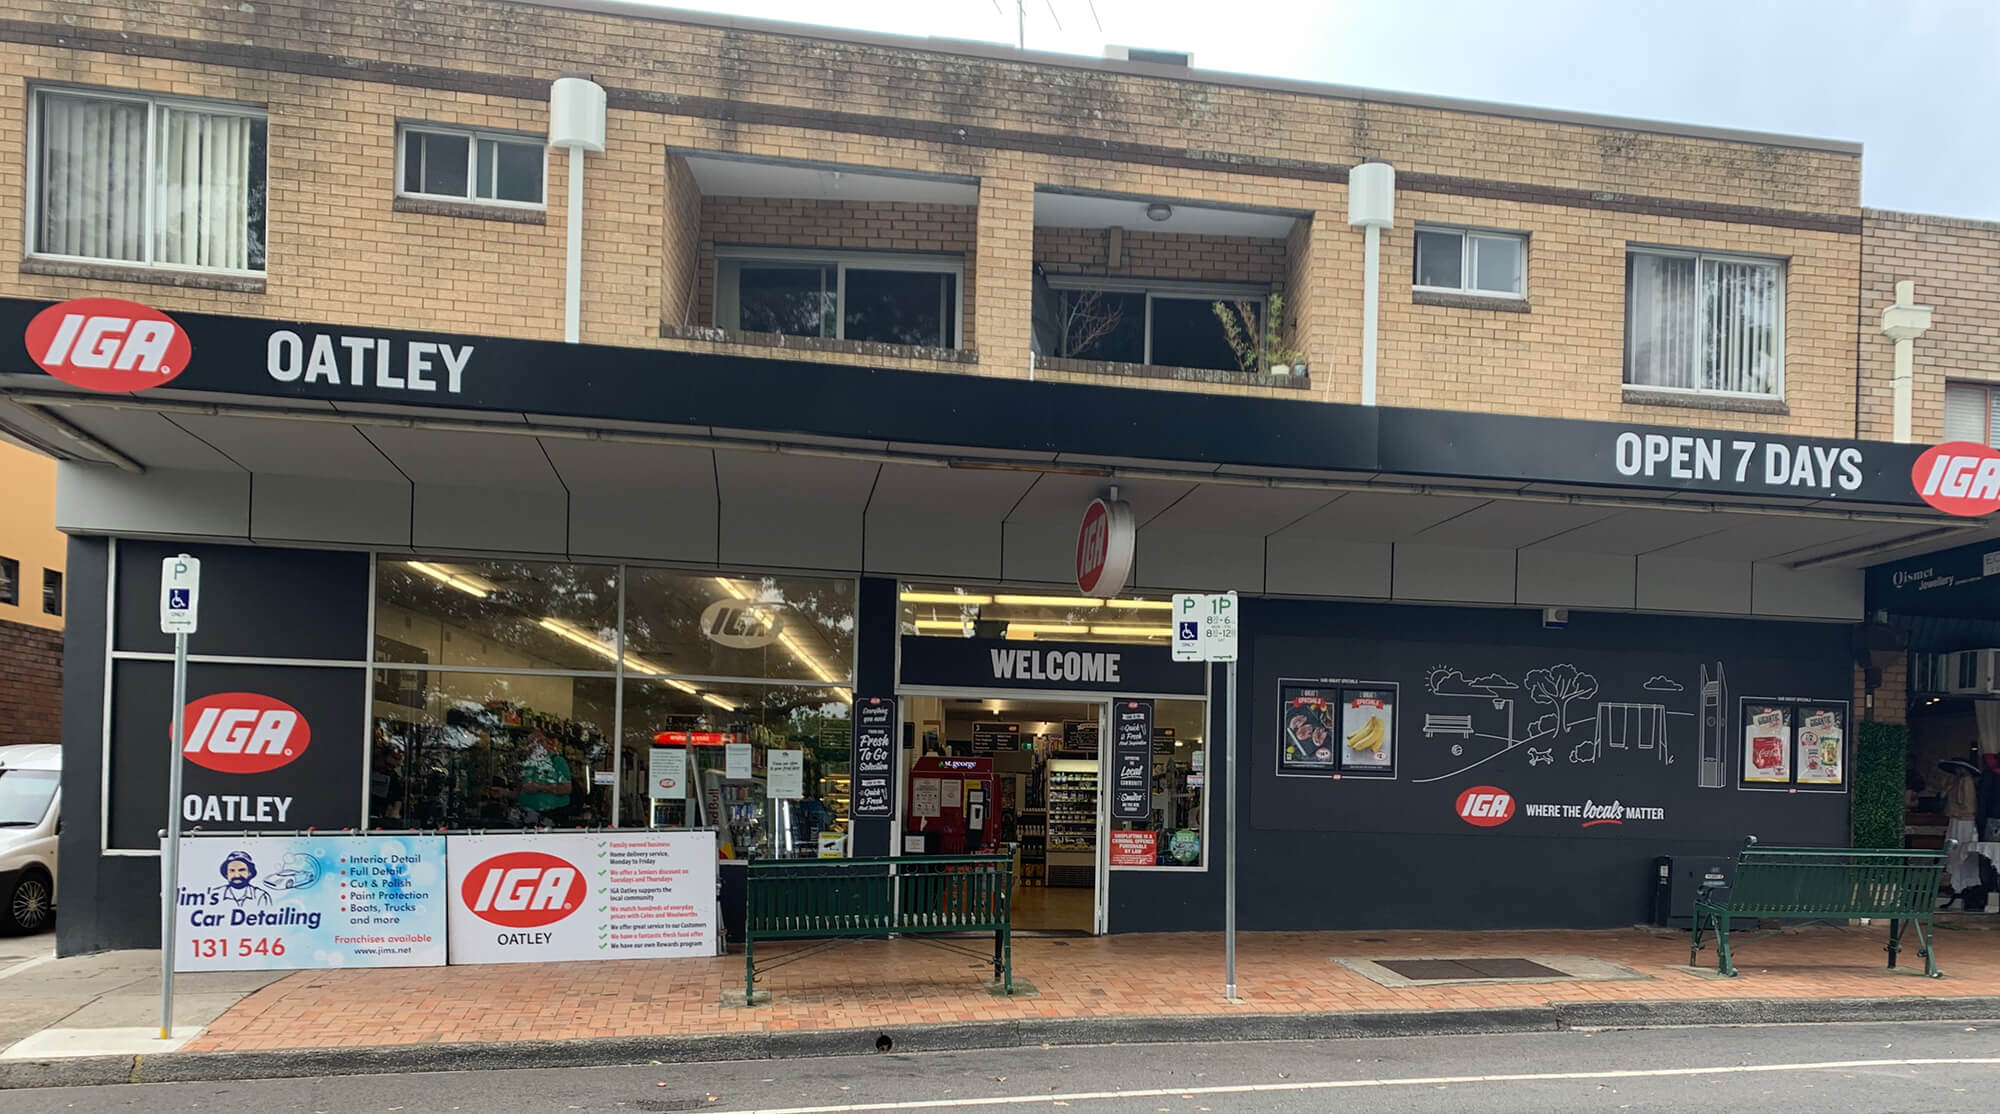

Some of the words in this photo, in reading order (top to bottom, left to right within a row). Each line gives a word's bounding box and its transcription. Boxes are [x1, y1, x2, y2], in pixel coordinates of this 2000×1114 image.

[42, 313, 175, 373] IGA
[267, 330, 474, 393] OATLEY
[1615, 432, 1722, 481] OPEN
[1732, 440, 1756, 482] 7
[1765, 443, 1863, 491] DAYS
[1080, 512, 1106, 579] IGA
[174, 561, 188, 580] P
[1183, 598, 1196, 614] P
[1212, 597, 1232, 614] 1P
[990, 648, 1121, 683] WELCOME
[183, 707, 298, 755] IGA
[860, 734, 889, 747] Fresh
[859, 748, 872, 761] To
[872, 748, 888, 761] Go
[1120, 765, 1143, 777] Local
[183, 794, 292, 822] OATLEY
[1461, 793, 1510, 818] IGA
[1526, 804, 1561, 817] WHERE
[1562, 805, 1581, 818] THE
[1582, 799, 1625, 820] locals
[1625, 807, 1664, 820] MATTER
[350, 855, 388, 863] Interior
[391, 854, 421, 863] Detail
[350, 867, 368, 876] Full
[372, 866, 402, 876] Detail
[350, 879, 368, 888] Cut
[371, 879, 378, 887] &
[382, 878, 412, 887] Polish
[473, 866, 577, 912] IGA
[350, 891, 376, 900] Paint
[379, 890, 429, 900] Protection
[350, 903, 381, 913] Boats,
[384, 903, 416, 911] Trucks
[190, 910, 225, 927] Car
[230, 907, 321, 930] Detailing
[350, 916, 370, 924] and
[373, 916, 400, 924] more
[334, 935, 385, 943] Franchises
[388, 934, 432, 943] available
[497, 932, 552, 946] OATLEY
[191, 938, 228, 958] 131
[238, 937, 286, 957] 546
[354, 946, 412, 955] www.jims.net
